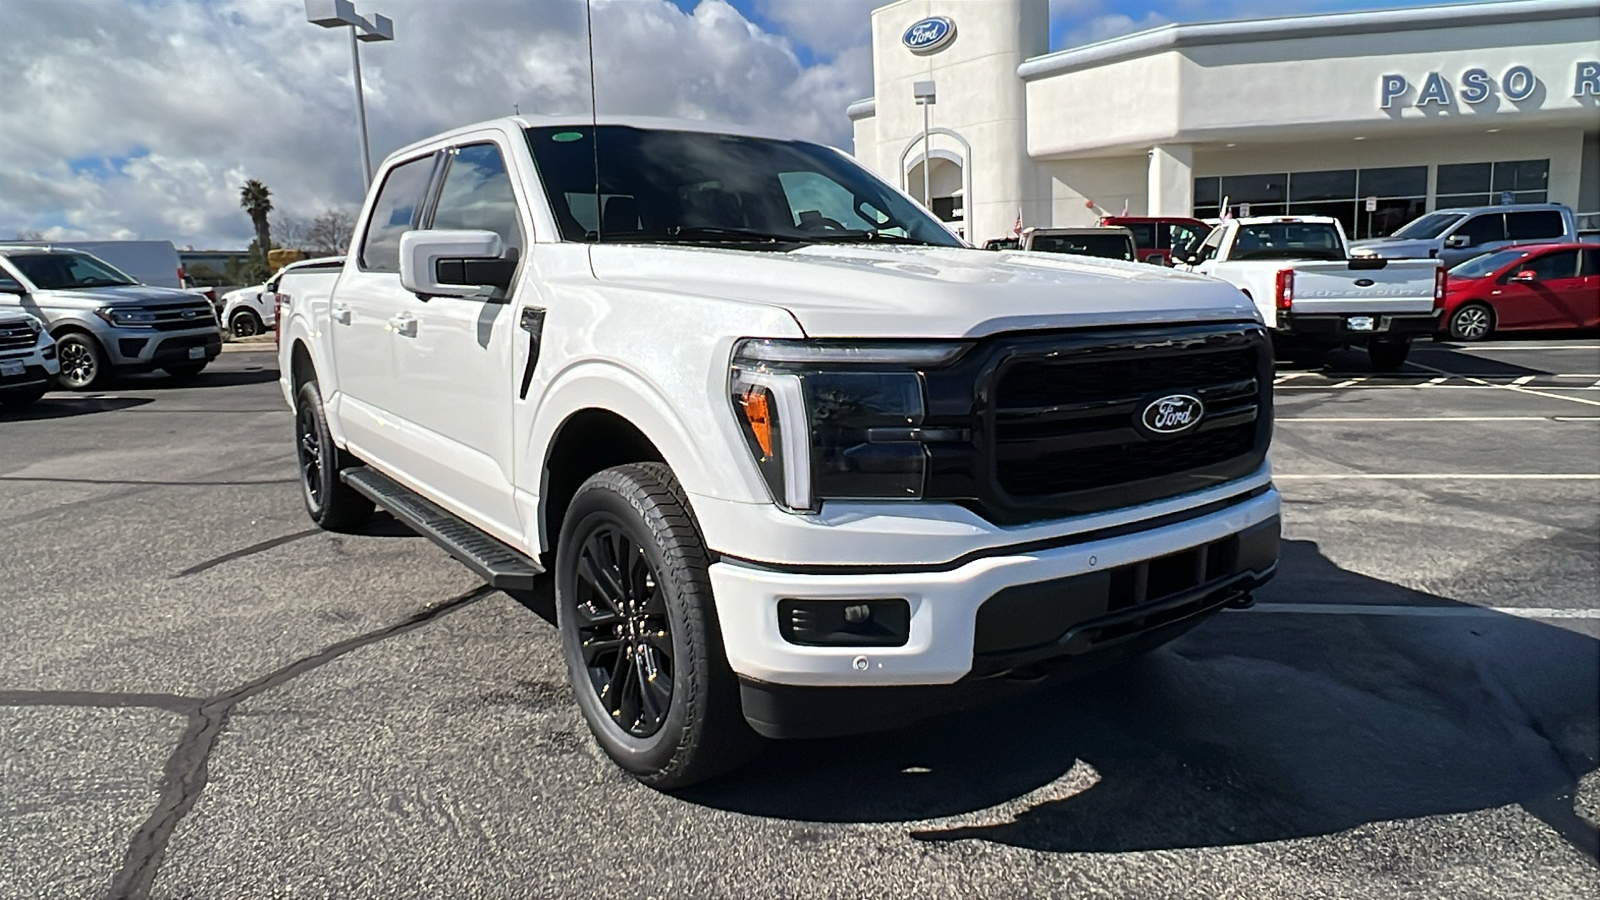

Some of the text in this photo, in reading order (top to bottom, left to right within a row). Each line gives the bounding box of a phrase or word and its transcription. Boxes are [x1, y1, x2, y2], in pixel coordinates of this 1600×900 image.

[910, 23, 939, 45] Ford
[1380, 65, 1536, 108] PASO
[1155, 401, 1192, 428] Ford
